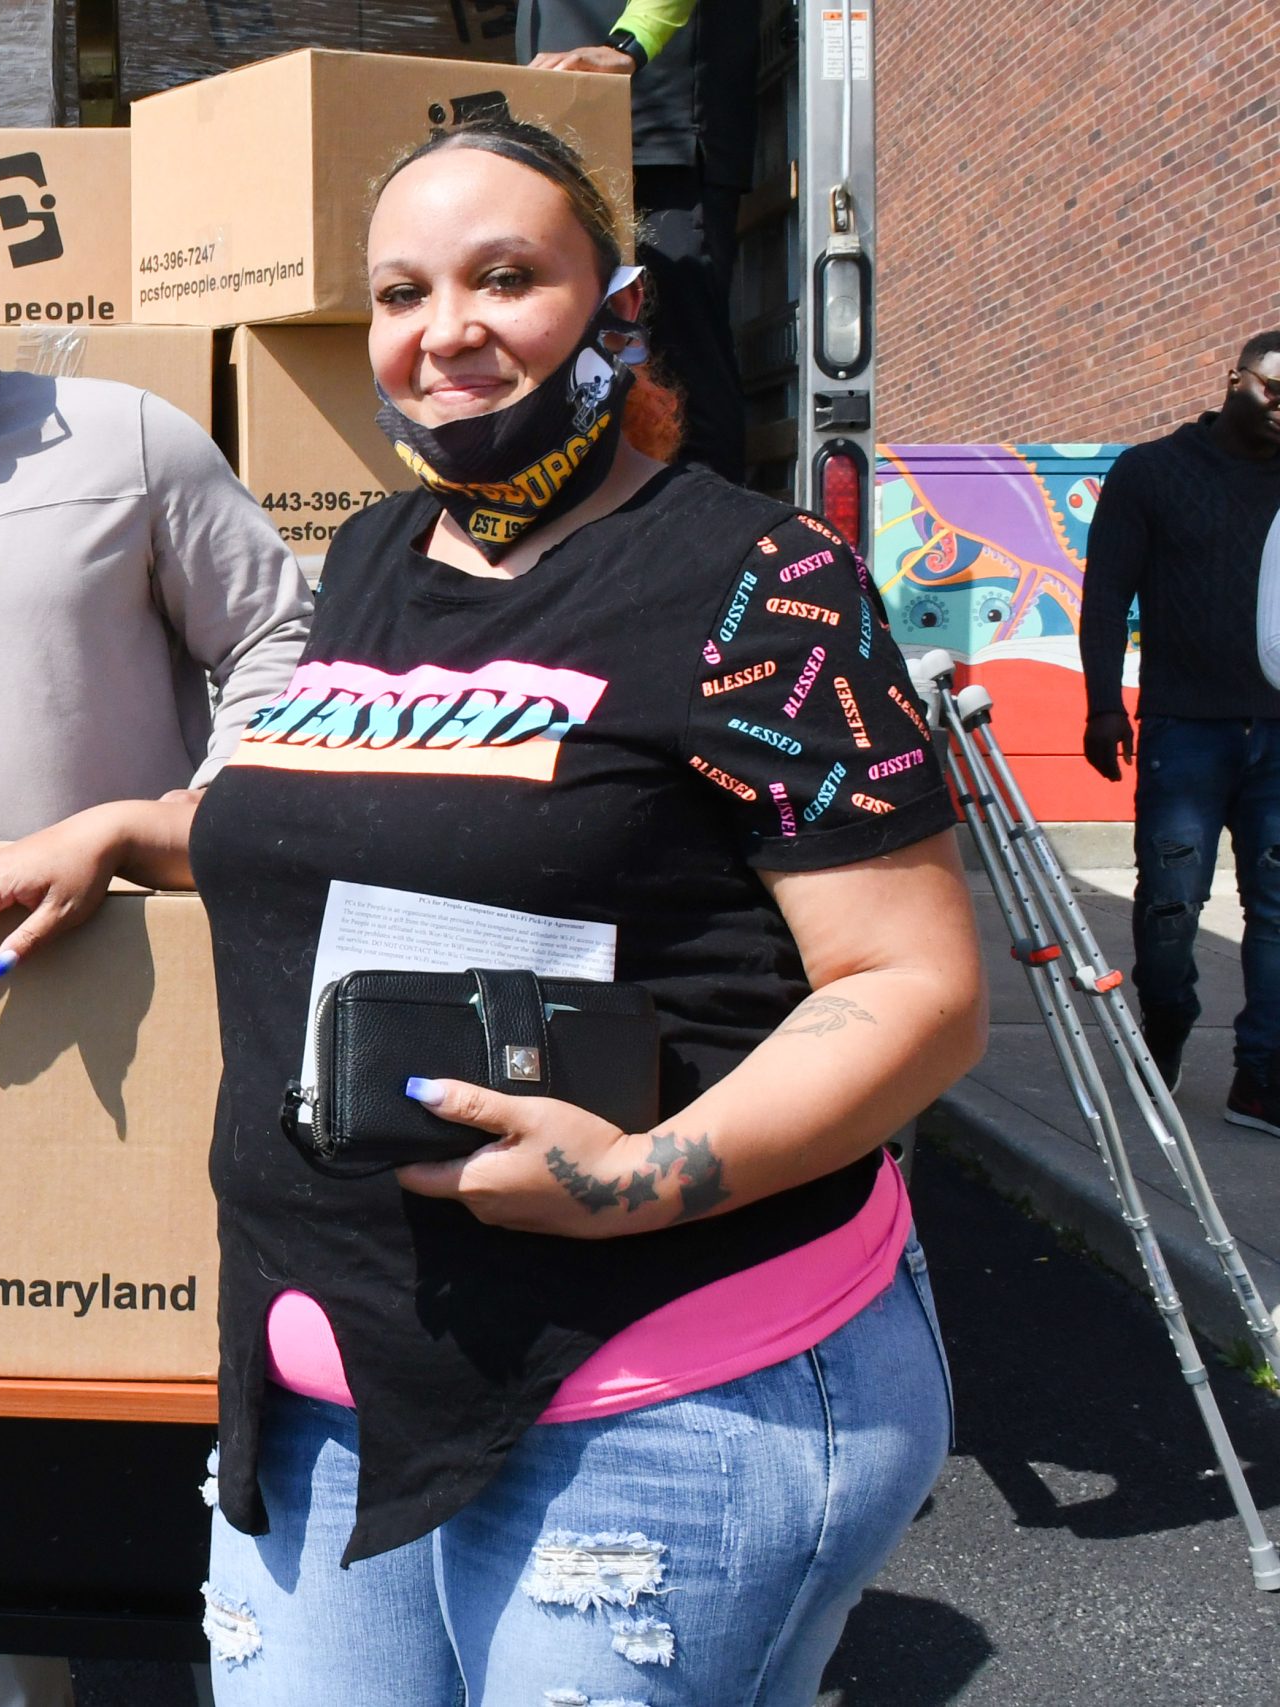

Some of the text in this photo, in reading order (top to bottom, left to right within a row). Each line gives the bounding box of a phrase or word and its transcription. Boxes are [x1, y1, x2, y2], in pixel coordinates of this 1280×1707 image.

[139, 244, 216, 275] 443-396-7247
[140, 257, 304, 306] pcsforpeople.org/maryland
[261, 491, 400, 512] 443-396-72
[779, 550, 835, 583] BLESSED
[719, 571, 758, 642] BLESSED
[765, 598, 841, 626] BLESSED
[701, 661, 776, 697] BLESSED
[783, 646, 826, 719] BLESSED
[833, 676, 872, 749] BLESSED
[727, 718, 802, 756] BLESSED
[688, 755, 757, 801] BLESSED
[868, 749, 924, 781] BLESSED
[803, 762, 847, 822] BLESSED
